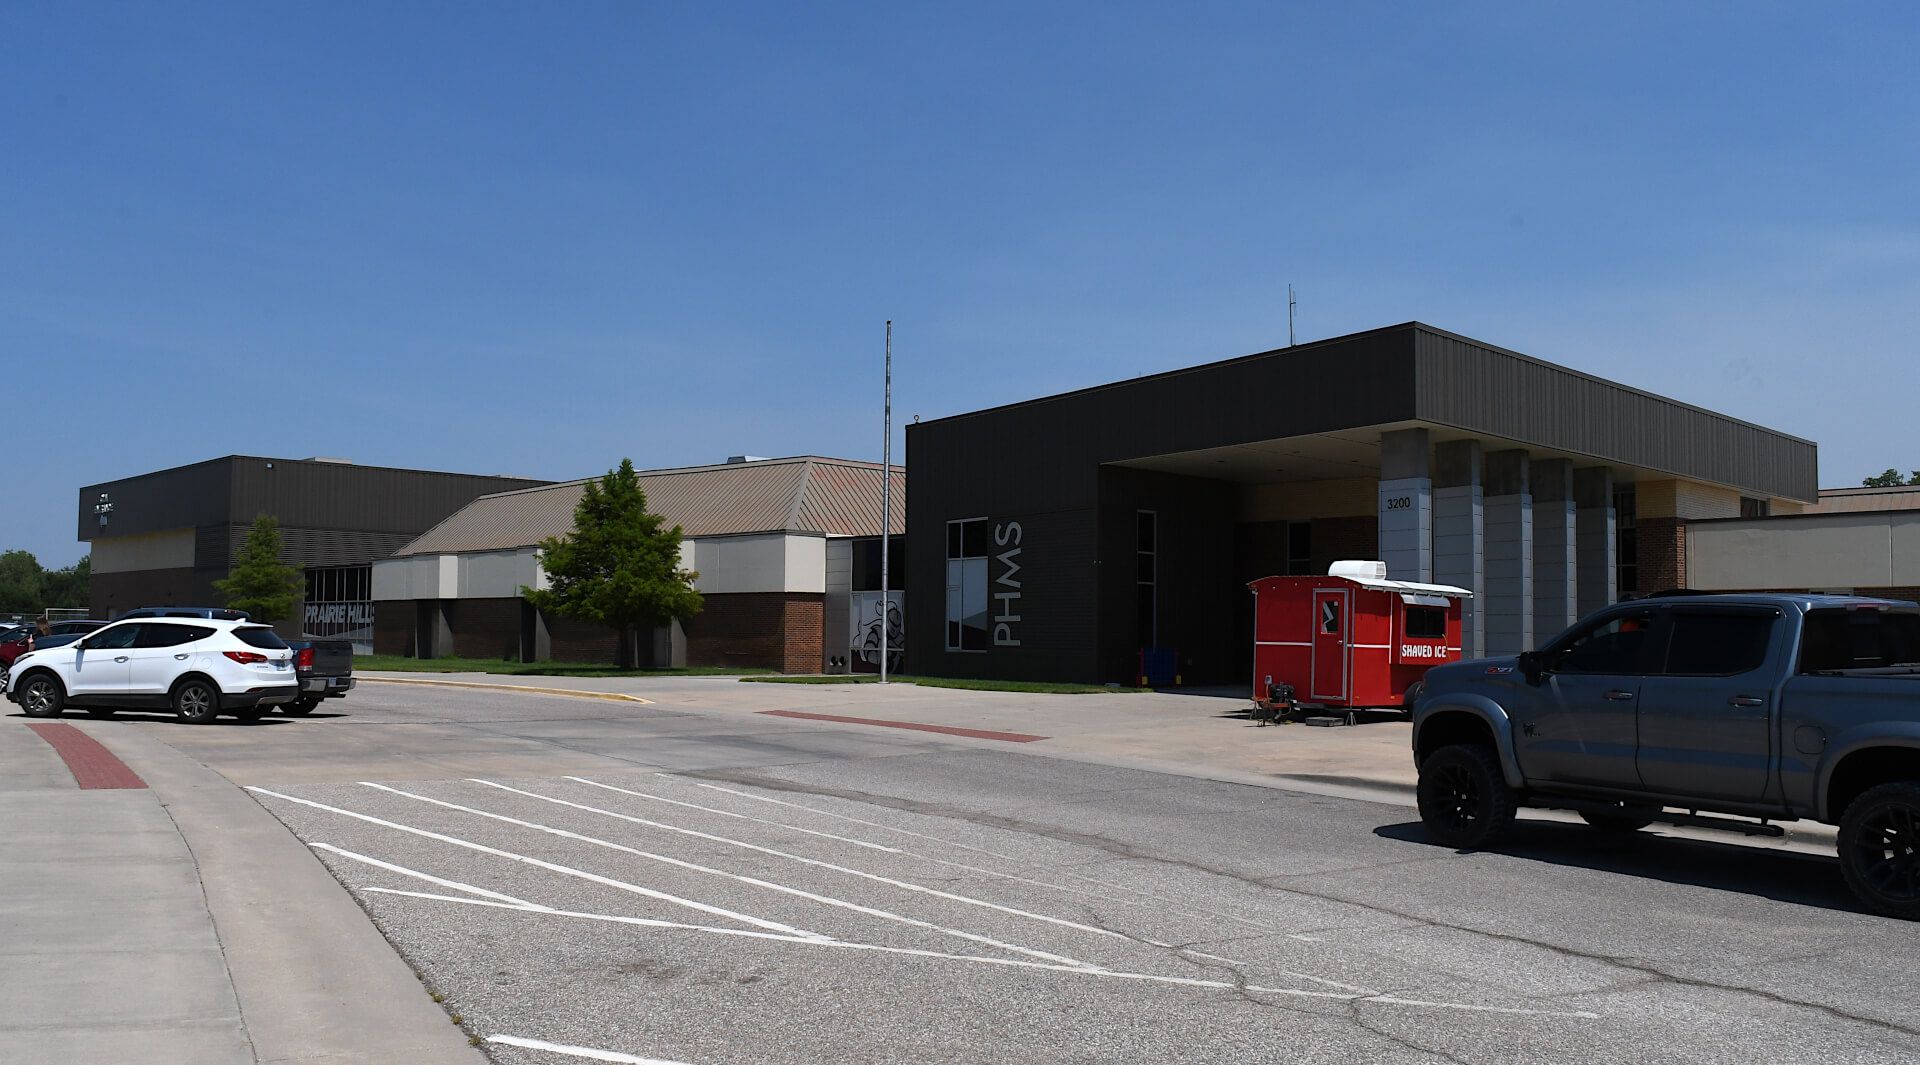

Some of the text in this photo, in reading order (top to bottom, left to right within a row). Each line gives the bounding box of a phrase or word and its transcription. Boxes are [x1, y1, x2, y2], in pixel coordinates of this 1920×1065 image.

[1387, 497, 1411, 509] 3200
[993, 521, 1022, 646] PHMS
[304, 604, 346, 623] PRAIRIE
[1401, 644, 1447, 658] SHAVED ICE
